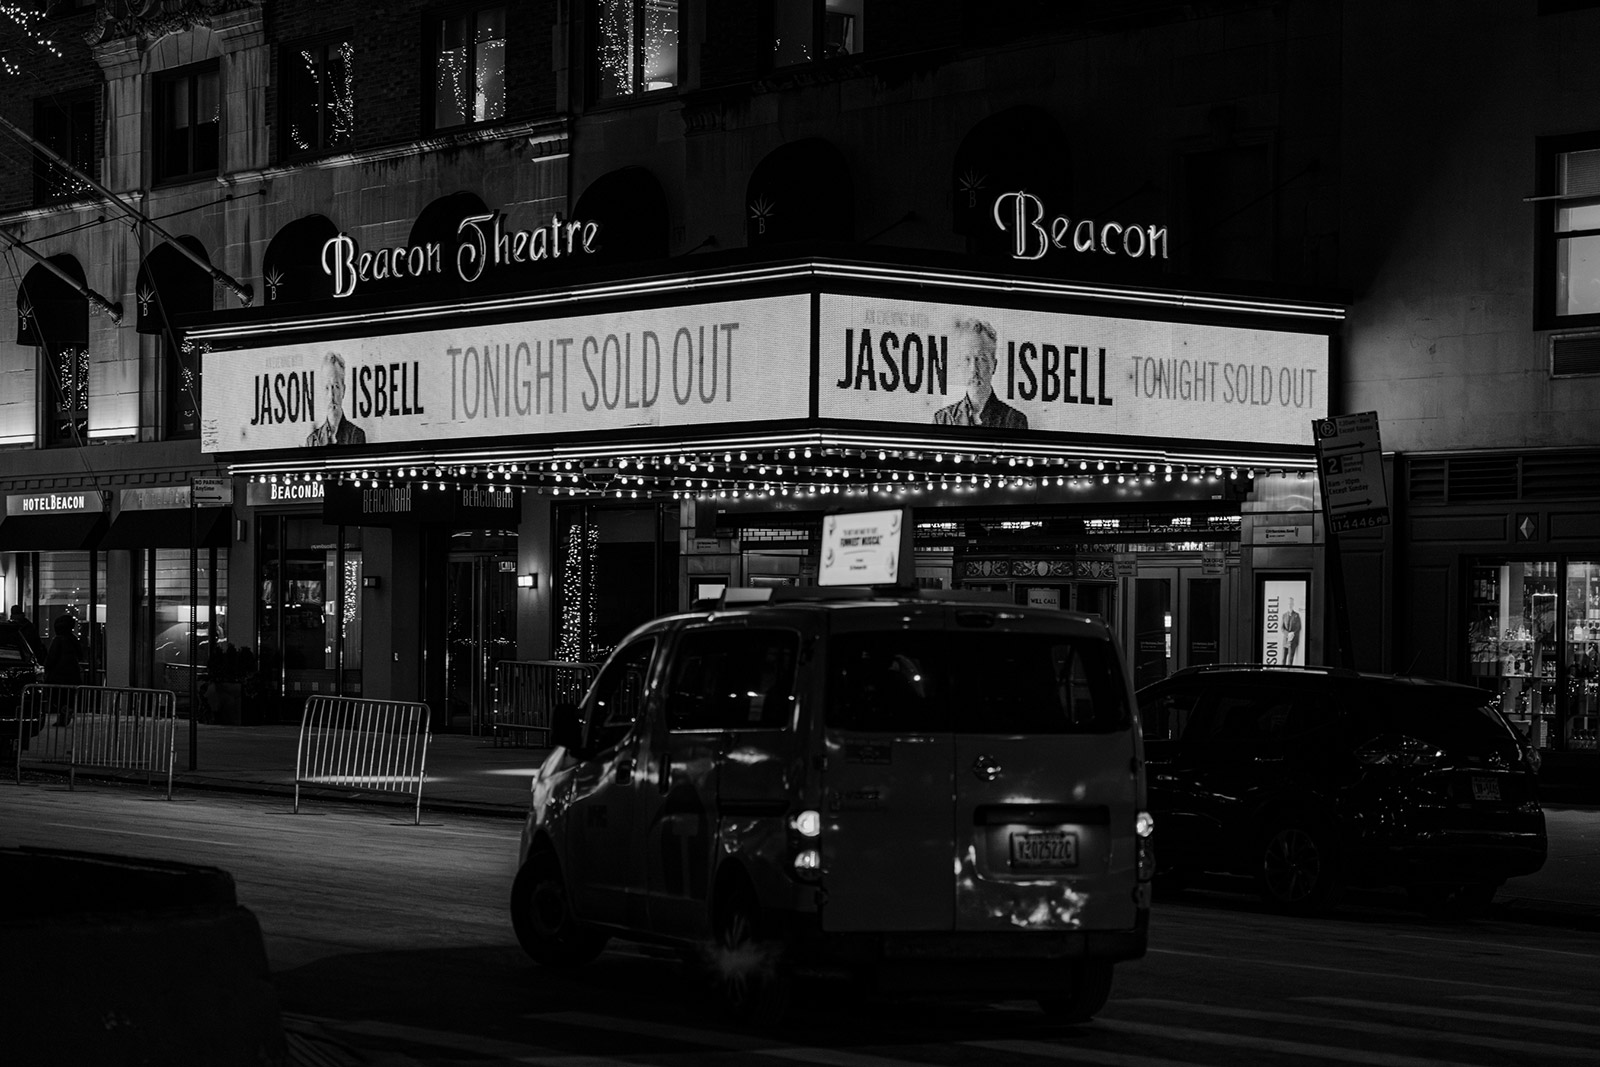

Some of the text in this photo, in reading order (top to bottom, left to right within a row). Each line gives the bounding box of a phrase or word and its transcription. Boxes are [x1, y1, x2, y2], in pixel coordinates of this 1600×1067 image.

[322, 211, 599, 298] Beacon Theatre
[992, 190, 1169, 261] Beacon
[250, 361, 424, 425] JASON ISBELL
[446, 323, 739, 419] TONIGHT SOLD OUT
[836, 328, 1113, 407] JASON ISBELL
[1130, 355, 1317, 409] TONIGHT SOLD OUT
[270, 481, 325, 500] BEACONBA
[1327, 458, 1338, 474] 2
[1349, 484, 1369, 492] Sunday
[1266, 595, 1279, 633] ISBELL
